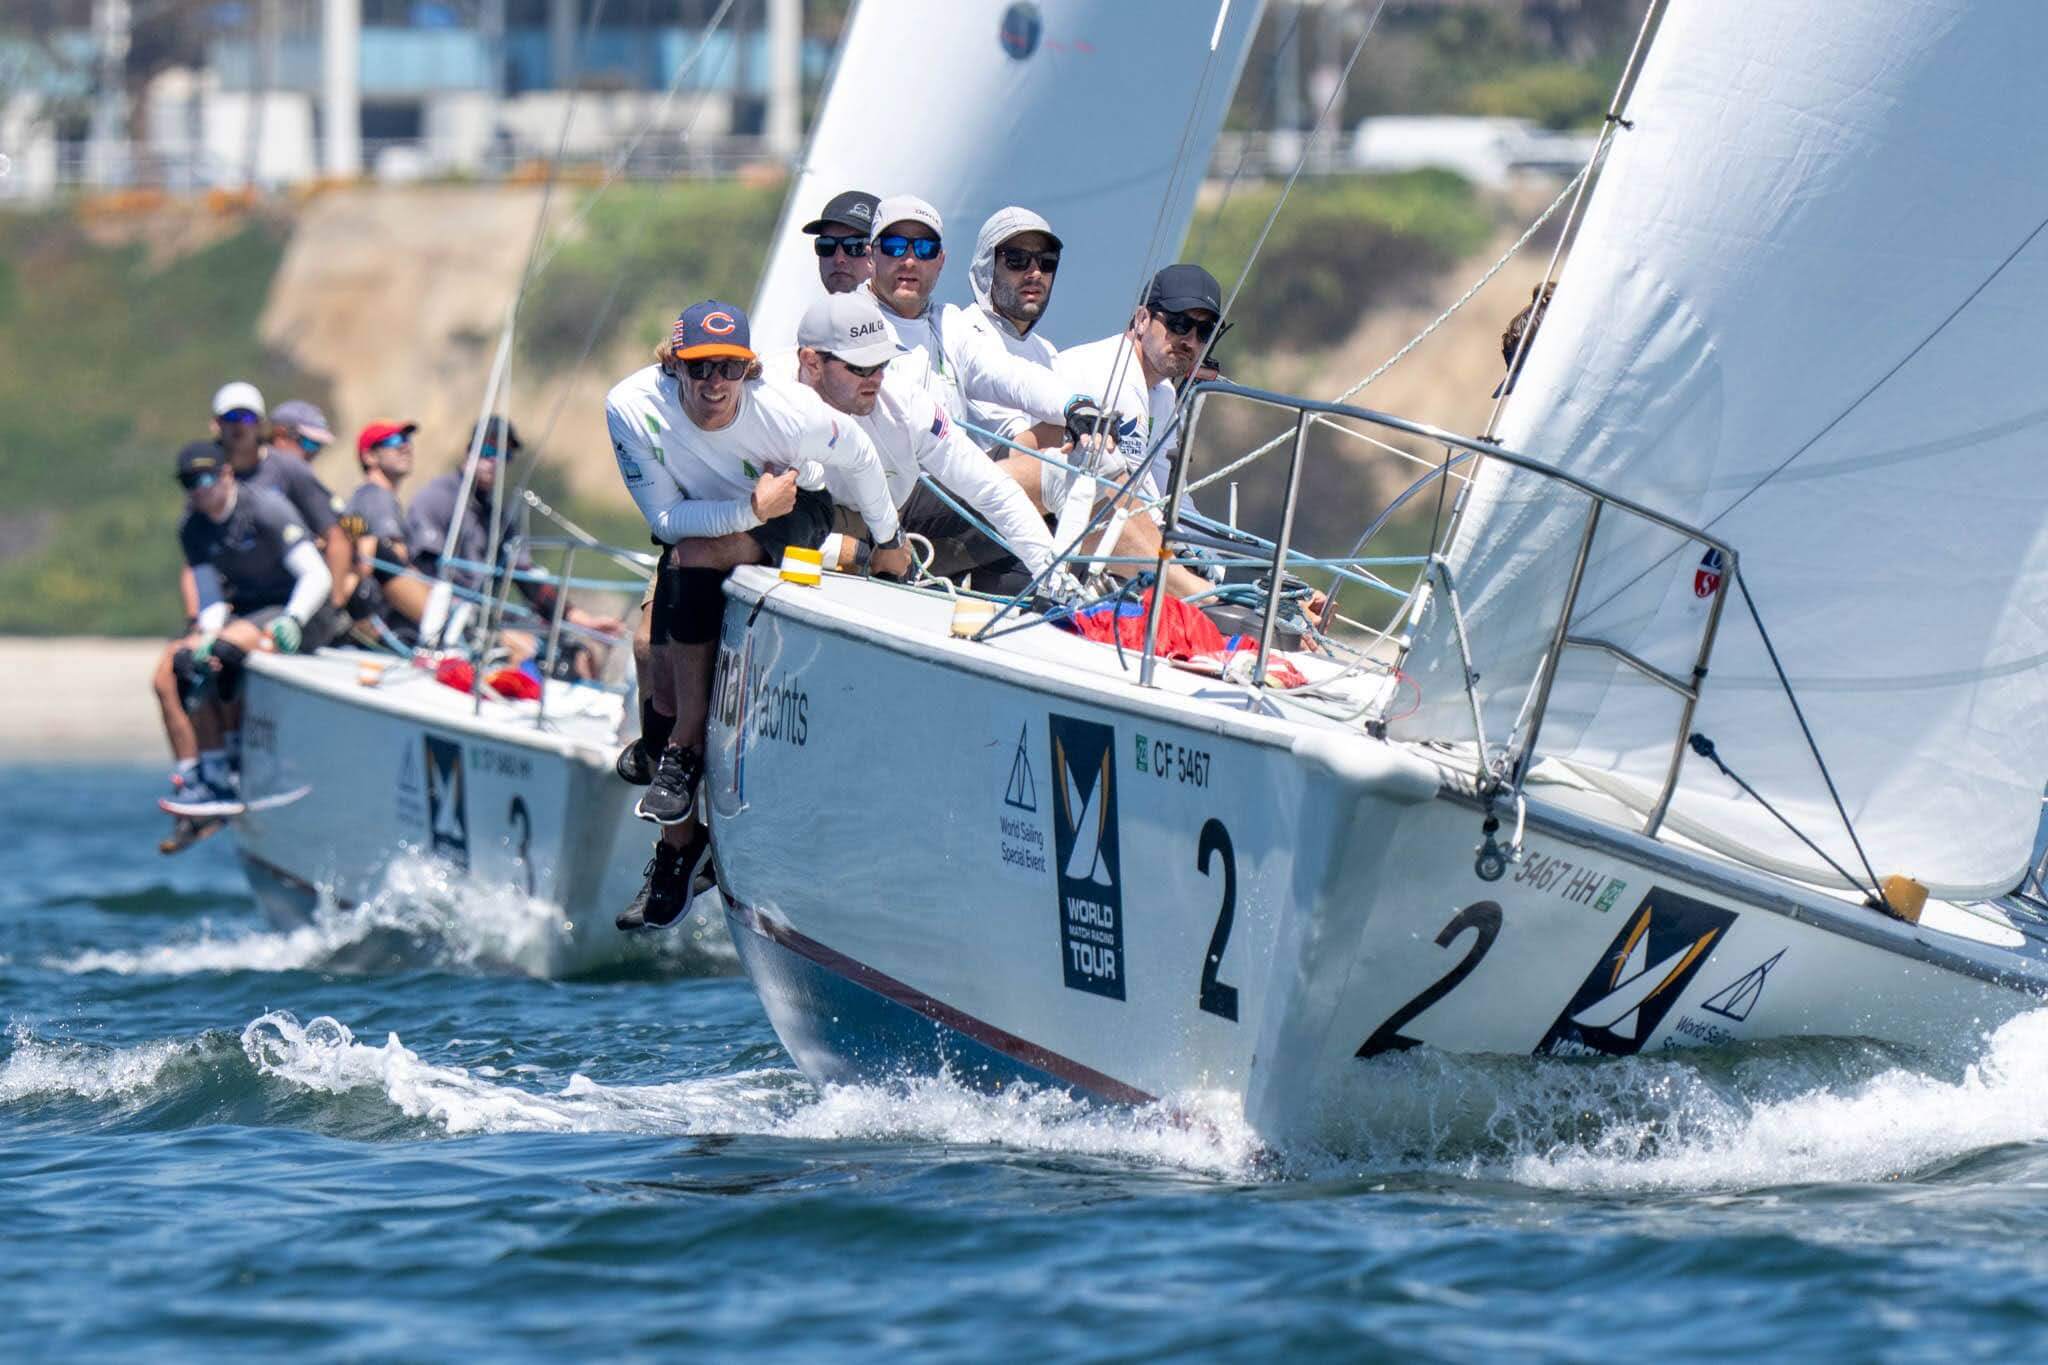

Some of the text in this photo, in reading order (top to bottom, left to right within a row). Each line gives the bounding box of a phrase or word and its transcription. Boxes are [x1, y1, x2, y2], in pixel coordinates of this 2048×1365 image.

[752, 663, 808, 746] Yachts
[1154, 740, 1173, 779] CF
[1178, 746, 1210, 789] 5467
[1000, 815, 1044, 851] World Sailing
[1001, 840, 1046, 873] Special Event
[1514, 852, 1573, 893] 5467
[1561, 867, 1606, 905] HH
[1067, 896, 1114, 930] WORLD
[1198, 817, 1239, 1024] 2
[1068, 924, 1115, 946] MATCH RACING
[1069, 940, 1117, 980] TOUR
[1354, 900, 1503, 1058] 2
[1675, 1015, 1712, 1038] World
